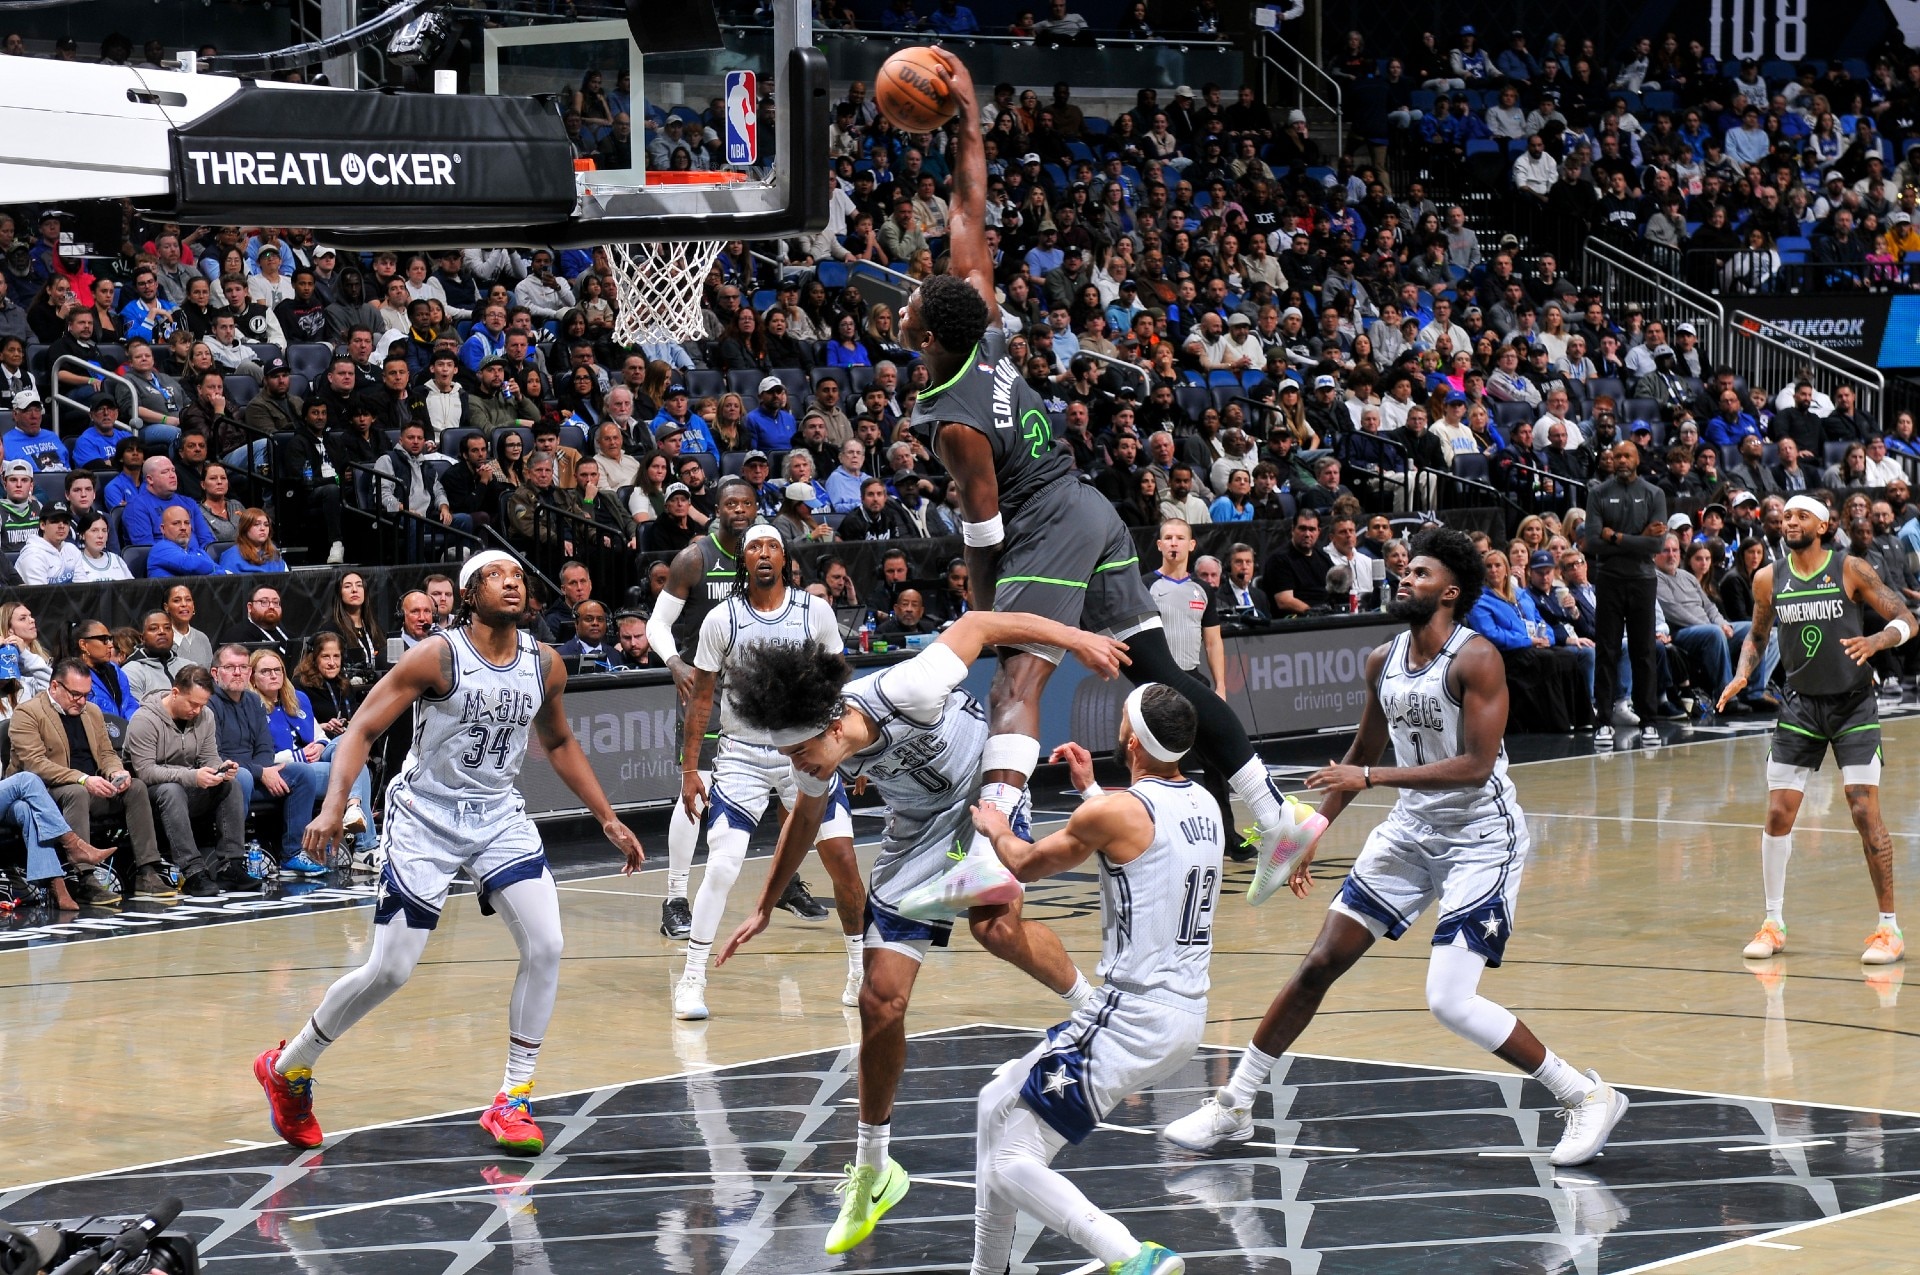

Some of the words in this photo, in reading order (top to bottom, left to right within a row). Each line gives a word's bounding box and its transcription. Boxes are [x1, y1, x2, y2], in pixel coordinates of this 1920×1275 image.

[1709, 0, 1807, 61] 108
[730, 143, 747, 159] NBA
[786, 620, 803, 631] Disney
[1774, 599, 1844, 625] TIMBERWOLVES
[1801, 624, 1823, 658] 9
[517, 669, 535, 679] Disney
[1250, 646, 1373, 692] Hankoo
[1293, 690, 1344, 714] driving
[1347, 690, 1368, 707] em
[461, 725, 515, 770] 34
[1409, 731, 1426, 765] 1
[906, 766, 952, 795] 0
[1180, 815, 1218, 846] QUEEN
[1176, 865, 1218, 946] 12
